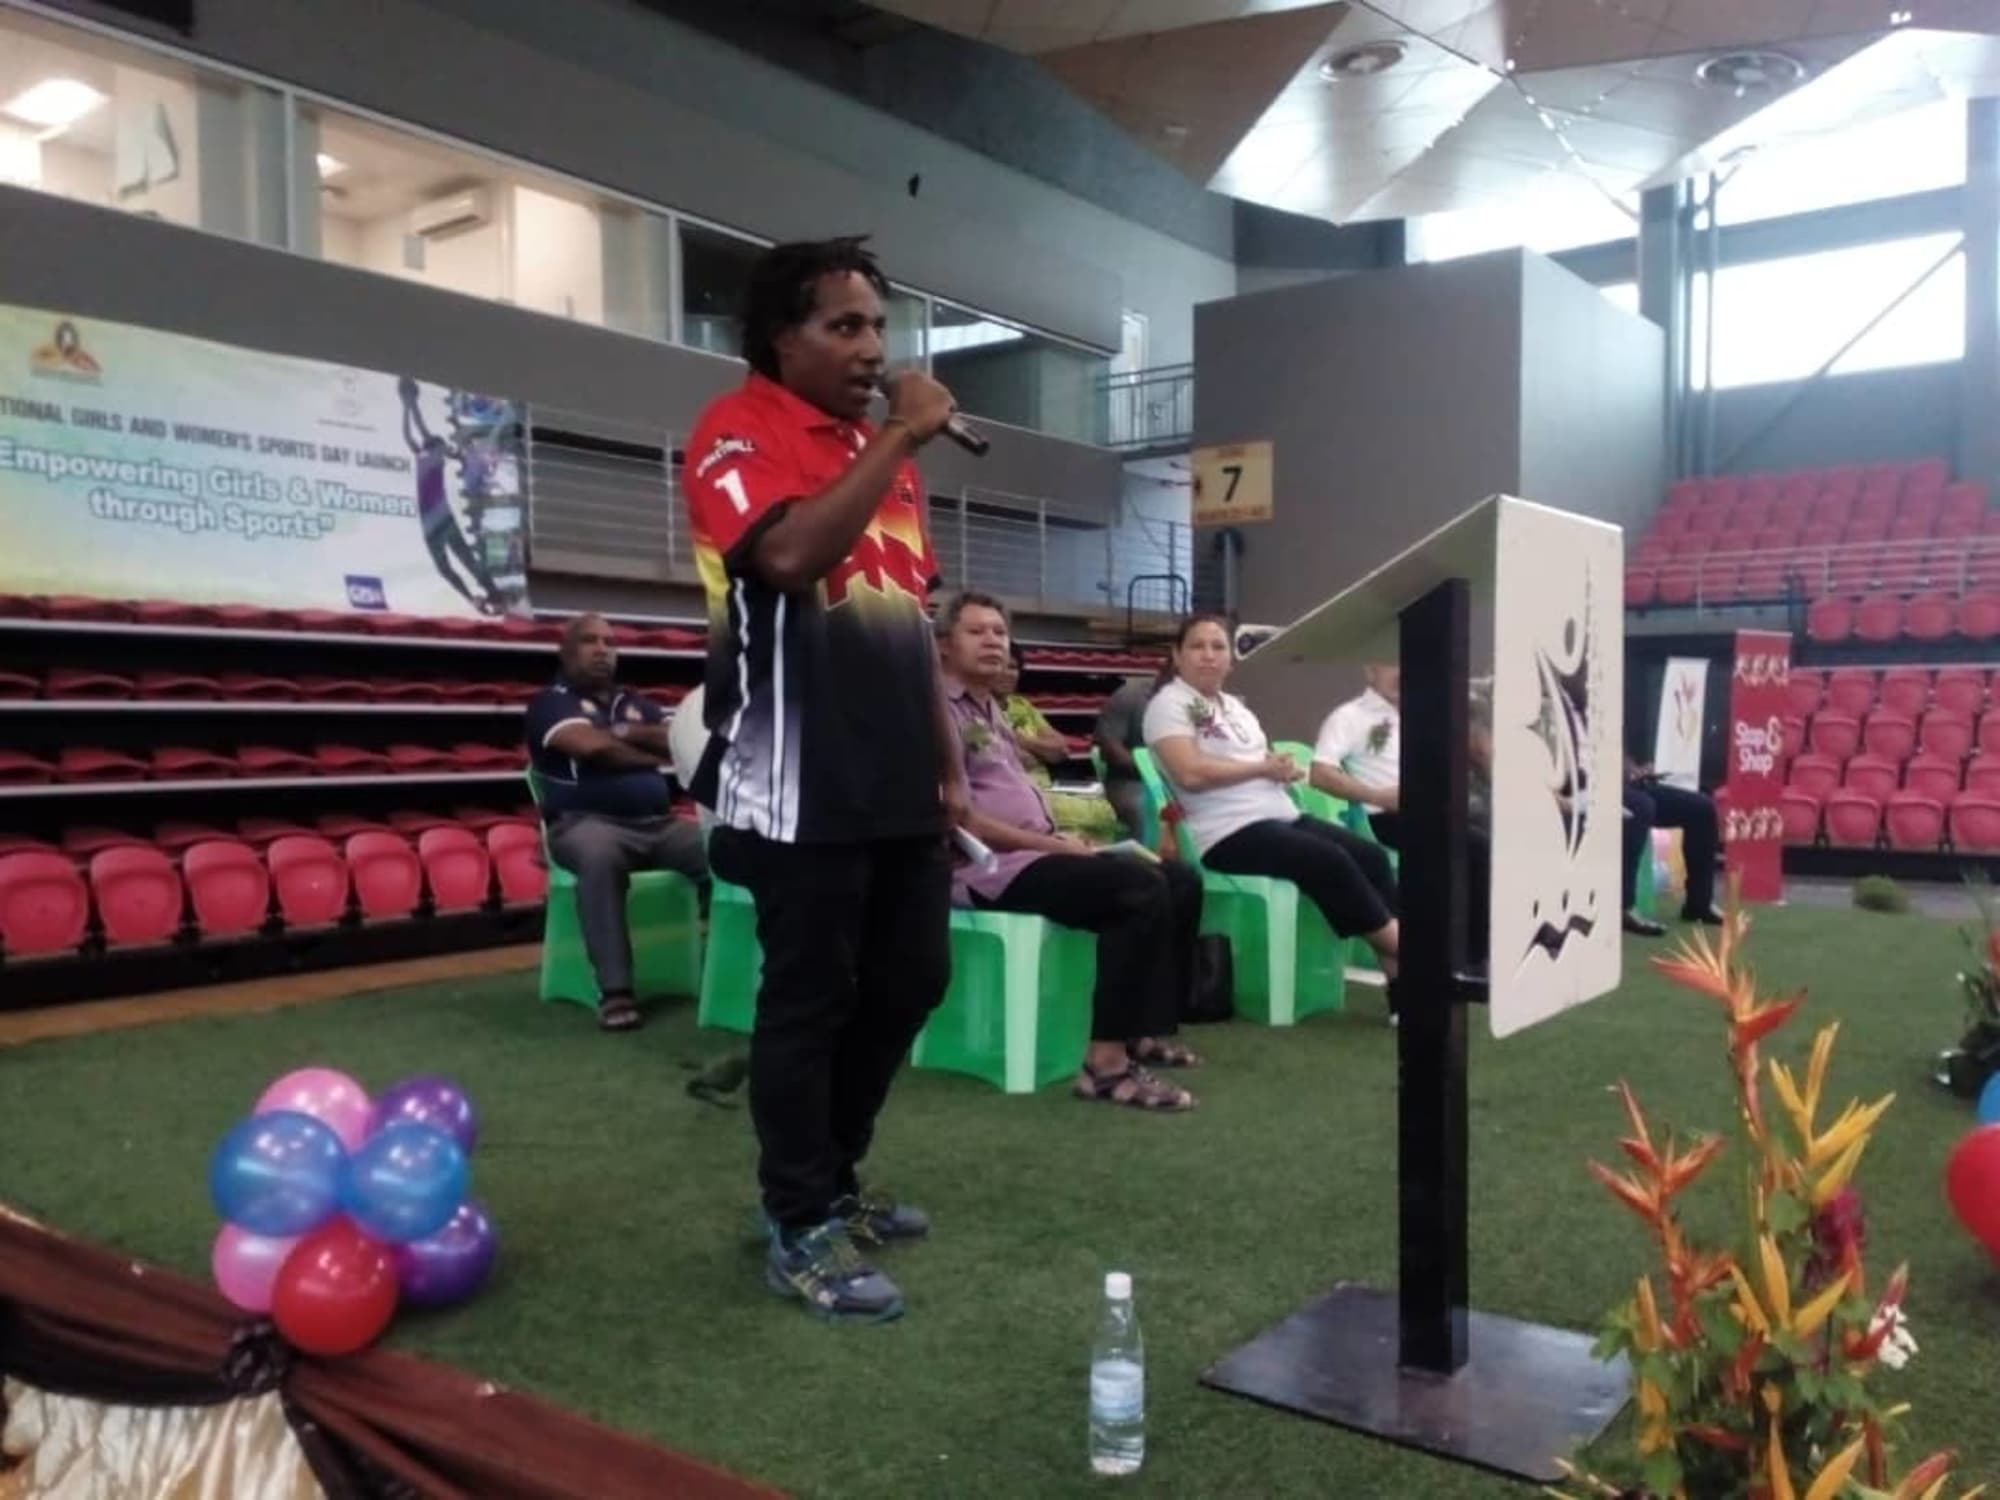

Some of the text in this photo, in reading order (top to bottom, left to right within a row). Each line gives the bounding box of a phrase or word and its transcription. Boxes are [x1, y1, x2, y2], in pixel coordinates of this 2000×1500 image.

[71, 407, 123, 432] GIRLS
[130, 416, 167, 438] AND
[173, 423, 253, 451] WOMEN'S
[258, 436, 316, 461] SPORTS
[321, 445, 350, 464] DAY
[355, 451, 410, 473] LAUNCH
[209, 466, 280, 501] Girls
[289, 476, 311, 504] &
[316, 480, 416, 517] Women
[713, 467, 750, 515] 1
[1222, 466, 1242, 502] 7
[90, 488, 217, 533] through
